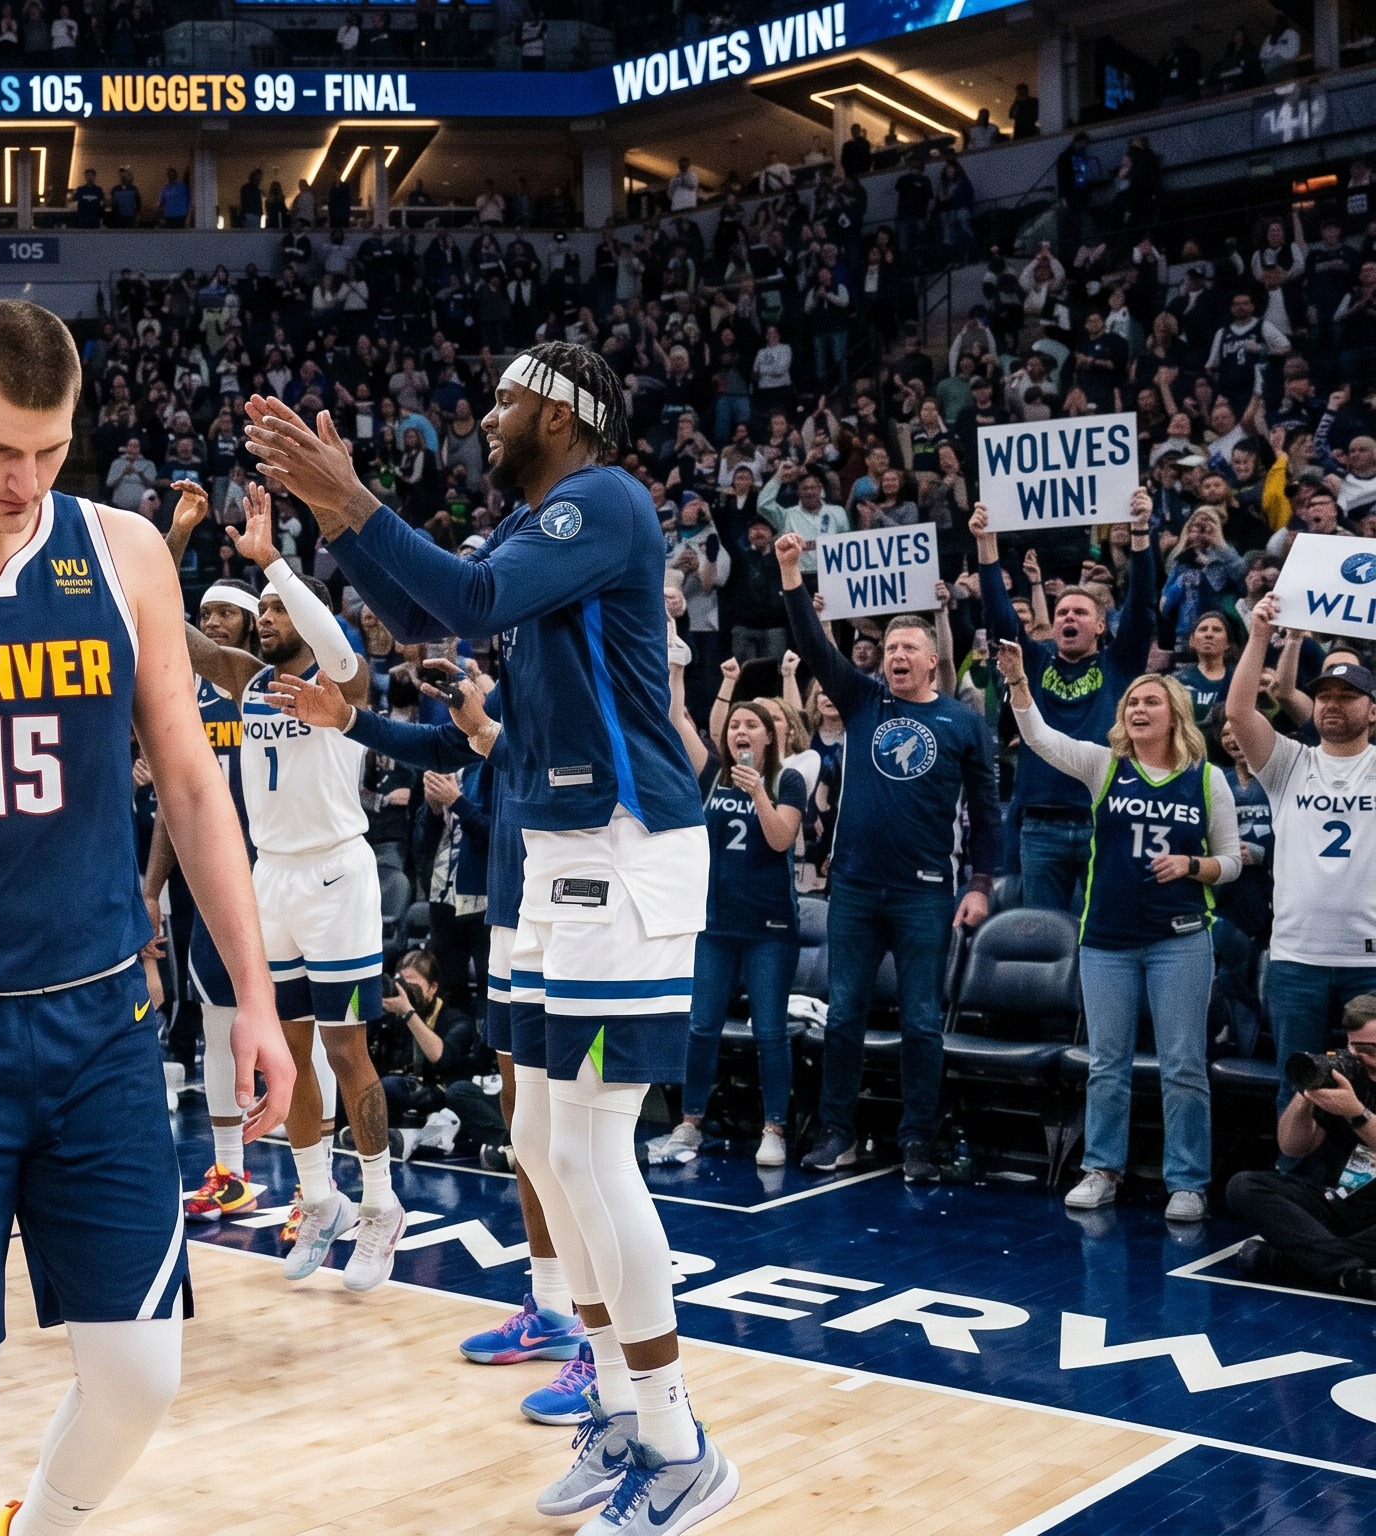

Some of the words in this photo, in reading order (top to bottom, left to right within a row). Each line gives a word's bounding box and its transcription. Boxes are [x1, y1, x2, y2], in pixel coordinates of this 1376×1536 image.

[612, 30, 751, 104] WOLVES
[758, 2, 846, 66] WIN!
[29, 75, 93, 118] 105,
[101, 75, 246, 112] NUGGETS
[254, 74, 296, 112] 99
[324, 74, 416, 112] FINAL
[9, 243, 44, 259] 105
[984, 424, 1131, 476] WOLVES
[1016, 474, 1098, 521] WIN!
[51, 559, 88, 576] WU
[822, 532, 931, 575] WOLVES
[846, 571, 907, 609] WIN!
[264, 746, 278, 791] 1
[710, 797, 757, 815] WOLV
[1108, 795, 1200, 825] WOLVES
[1296, 794, 1376, 814] WOLVE
[726, 819, 747, 850] 2
[1131, 823, 1173, 858] 13
[1318, 820, 1352, 858] 2
